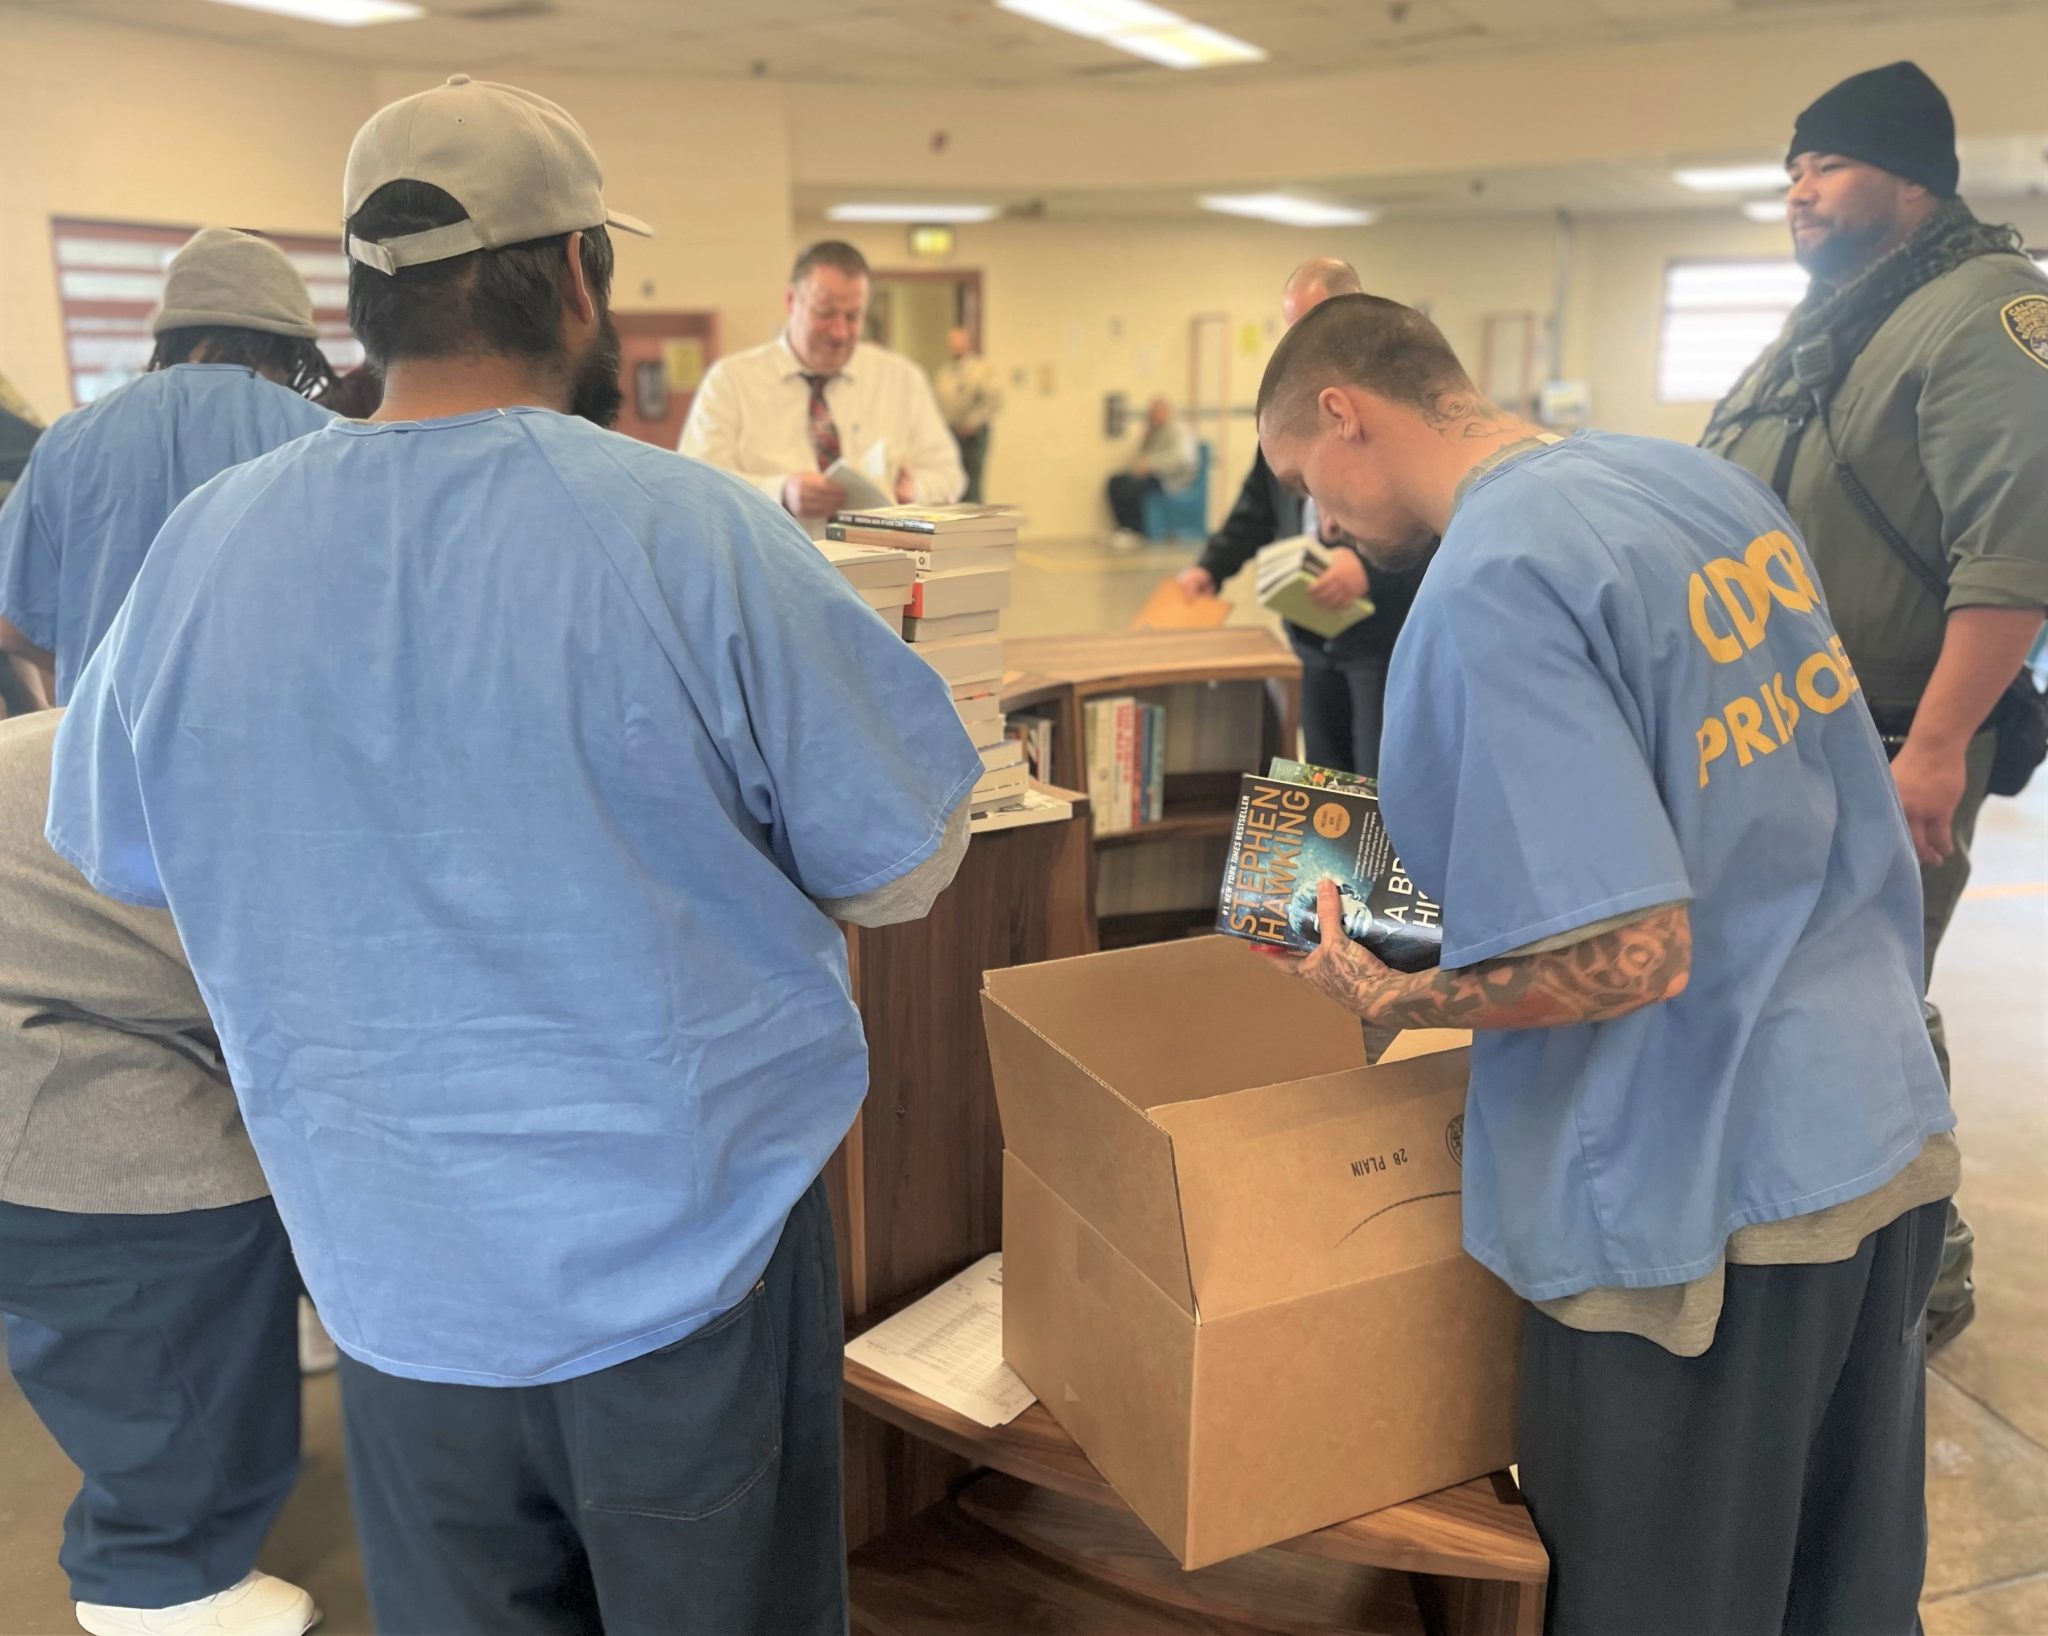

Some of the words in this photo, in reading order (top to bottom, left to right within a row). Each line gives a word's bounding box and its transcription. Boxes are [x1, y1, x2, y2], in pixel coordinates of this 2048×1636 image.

[1235, 795, 1250, 841] BESTSELLER
[1230, 842, 1242, 864] TIMES
[1230, 785, 1281, 934] STEPHEN
[1226, 865, 1239, 885] YORK
[1258, 790, 1310, 940] HAWKING
[1223, 886, 1234, 904] NEW
[1221, 905, 1231, 916] #1
[1384, 906, 1409, 925] A
[1413, 890, 1440, 928] HI
[1351, 1155, 1387, 1177] PLAIN
